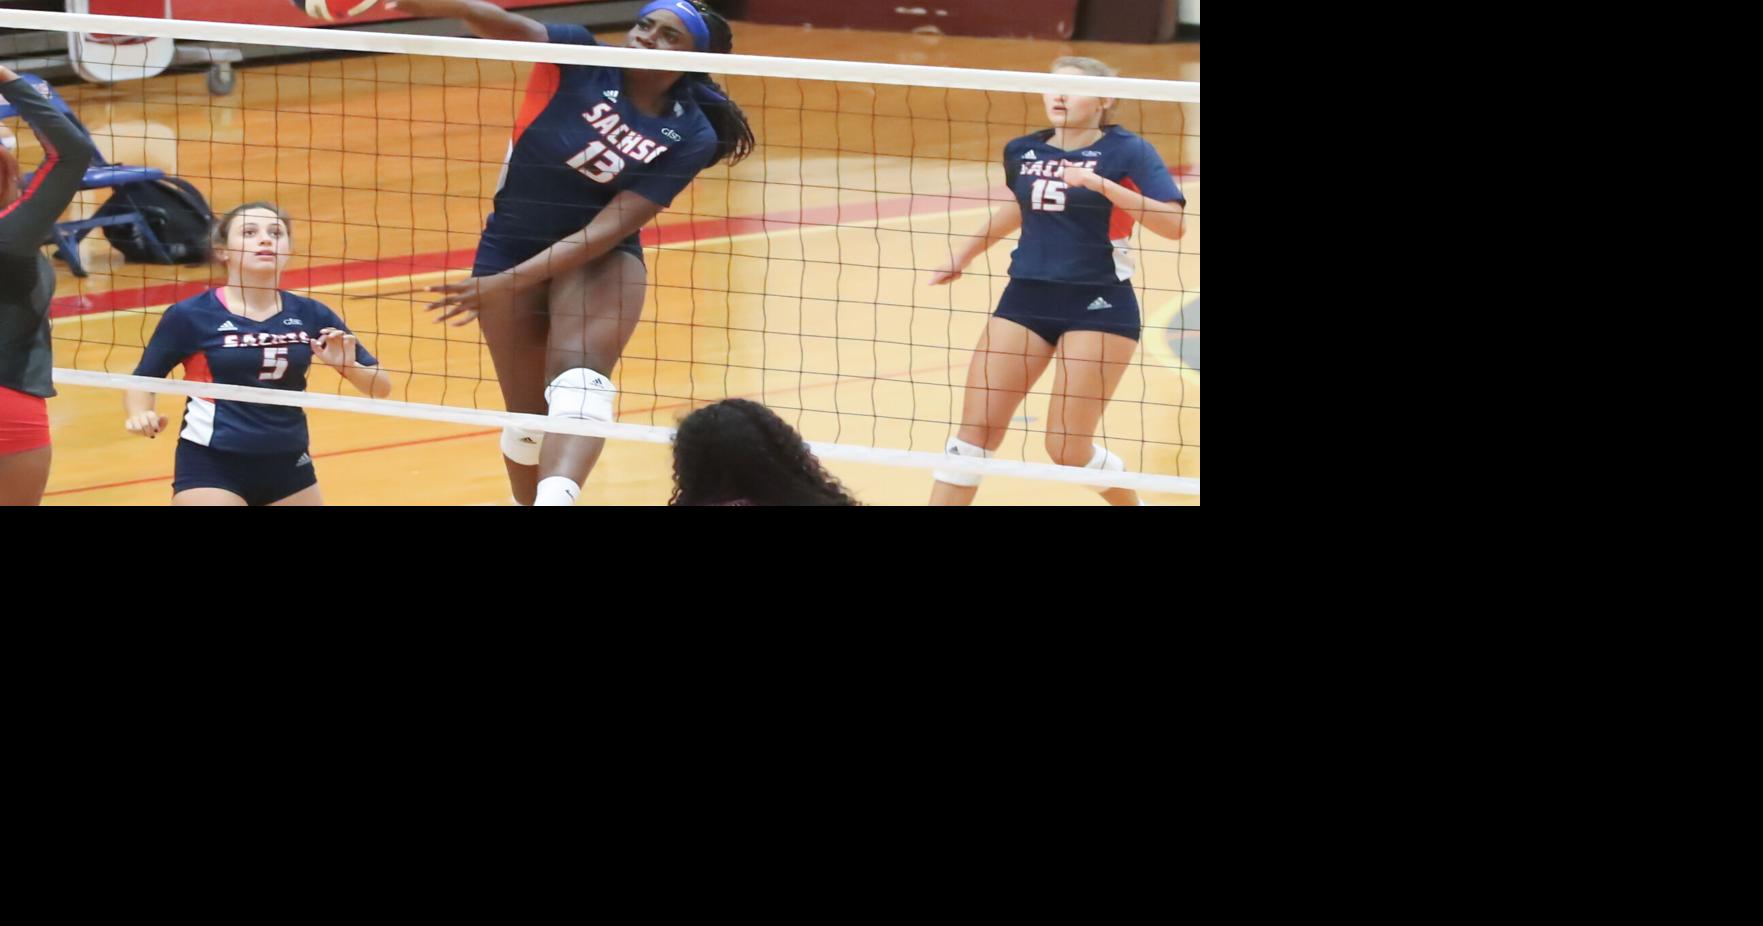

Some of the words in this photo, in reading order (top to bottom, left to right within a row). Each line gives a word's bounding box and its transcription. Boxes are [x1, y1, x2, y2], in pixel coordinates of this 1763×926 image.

[565, 140, 625, 184] 13
[1019, 159, 1098, 178] SACE
[1030, 178, 1068, 211] 15
[258, 346, 289, 381] 5
